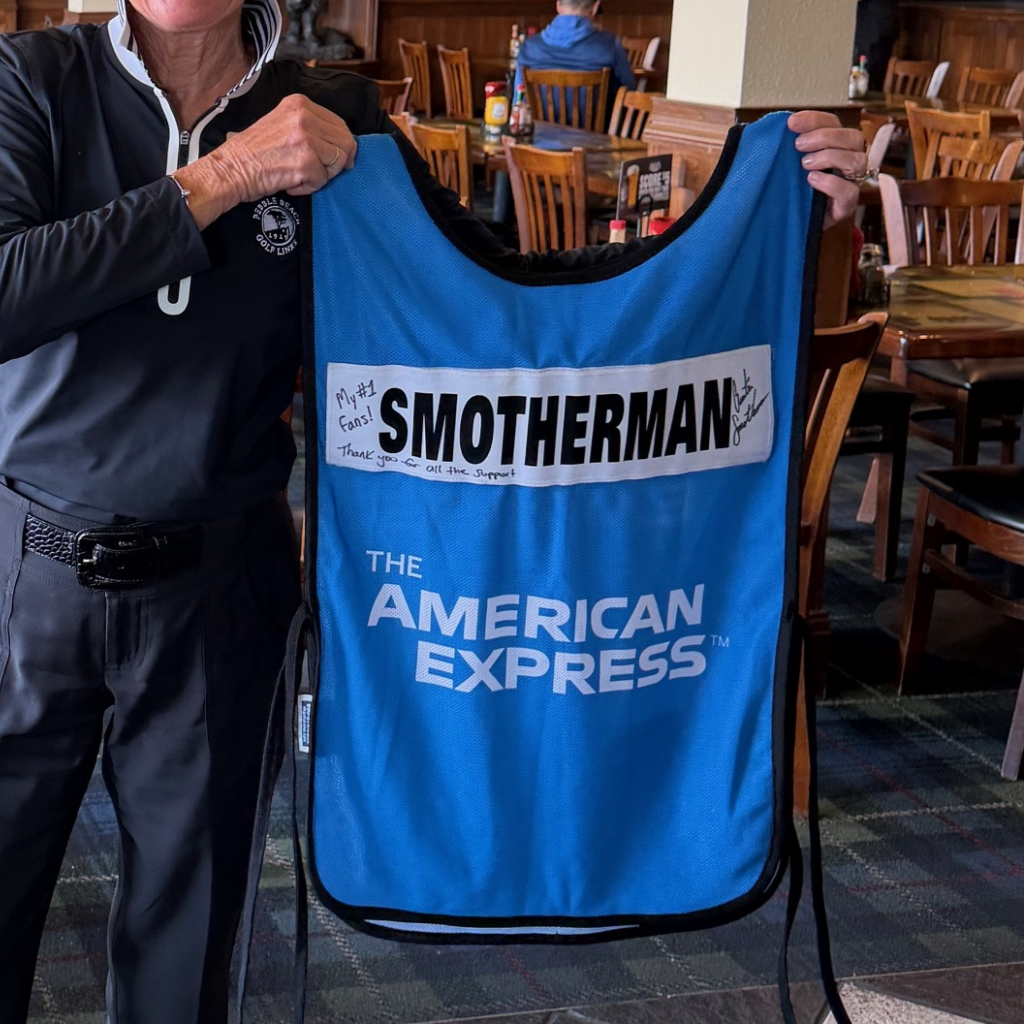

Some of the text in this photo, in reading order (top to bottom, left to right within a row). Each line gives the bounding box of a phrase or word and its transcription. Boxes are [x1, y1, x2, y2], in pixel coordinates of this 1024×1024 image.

[252, 197, 300, 225] PEBBLE BEACH
[256, 234, 298, 256] GOLF LINKS
[336, 380, 377, 410] My #1
[378, 377, 732, 467] SMOTHERMAN
[337, 443, 376, 459] Thank
[377, 454, 398, 467] you
[401, 458, 421, 468] for
[425, 464, 443, 474] all
[446, 465, 470, 476] the
[366, 549, 422, 578] THE
[367, 583, 704, 643] AMERICAN
[415, 634, 706, 695] EXPRESS
